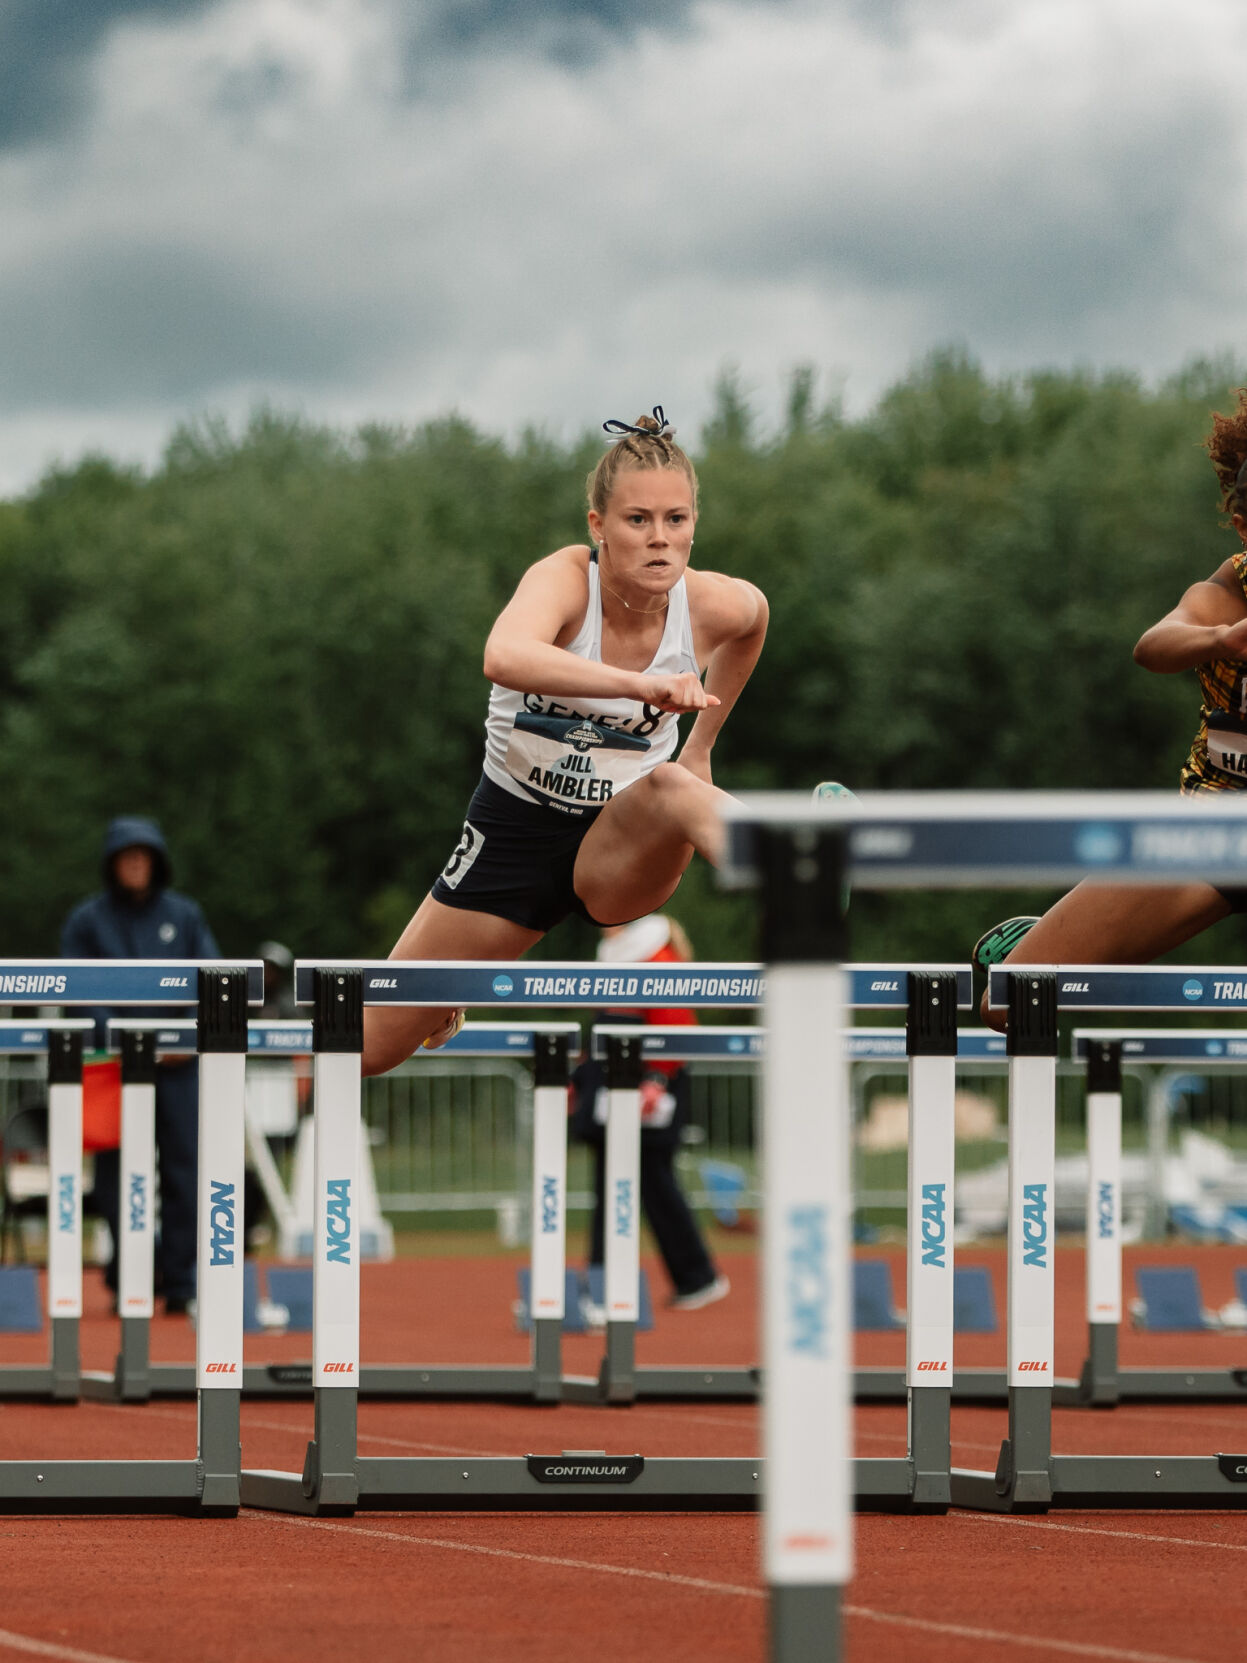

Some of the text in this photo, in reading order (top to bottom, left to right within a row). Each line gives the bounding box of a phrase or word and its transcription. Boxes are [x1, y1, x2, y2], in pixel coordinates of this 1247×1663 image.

[632, 701, 666, 737] 8
[560, 754, 592, 774] JILL
[527, 766, 613, 802] AMBLER
[0, 975, 67, 993] NSHIPS
[160, 977, 188, 987] GILL
[369, 978, 398, 988] GILL
[524, 977, 768, 996] TRACK & FIELD CHAMPIONSHIP
[870, 981, 899, 991] GILL
[1062, 982, 1090, 992] GILL
[210, 1180, 235, 1267] NCAA
[327, 1179, 351, 1265] NCAA
[922, 1183, 946, 1268] NCAA
[1023, 1183, 1047, 1268] NCAA
[205, 1363, 236, 1373] GILL
[323, 1363, 354, 1373] GILL
[917, 1361, 948, 1371] GILL
[1018, 1361, 1048, 1371] GILL
[545, 1466, 627, 1475] CONTINUUM
